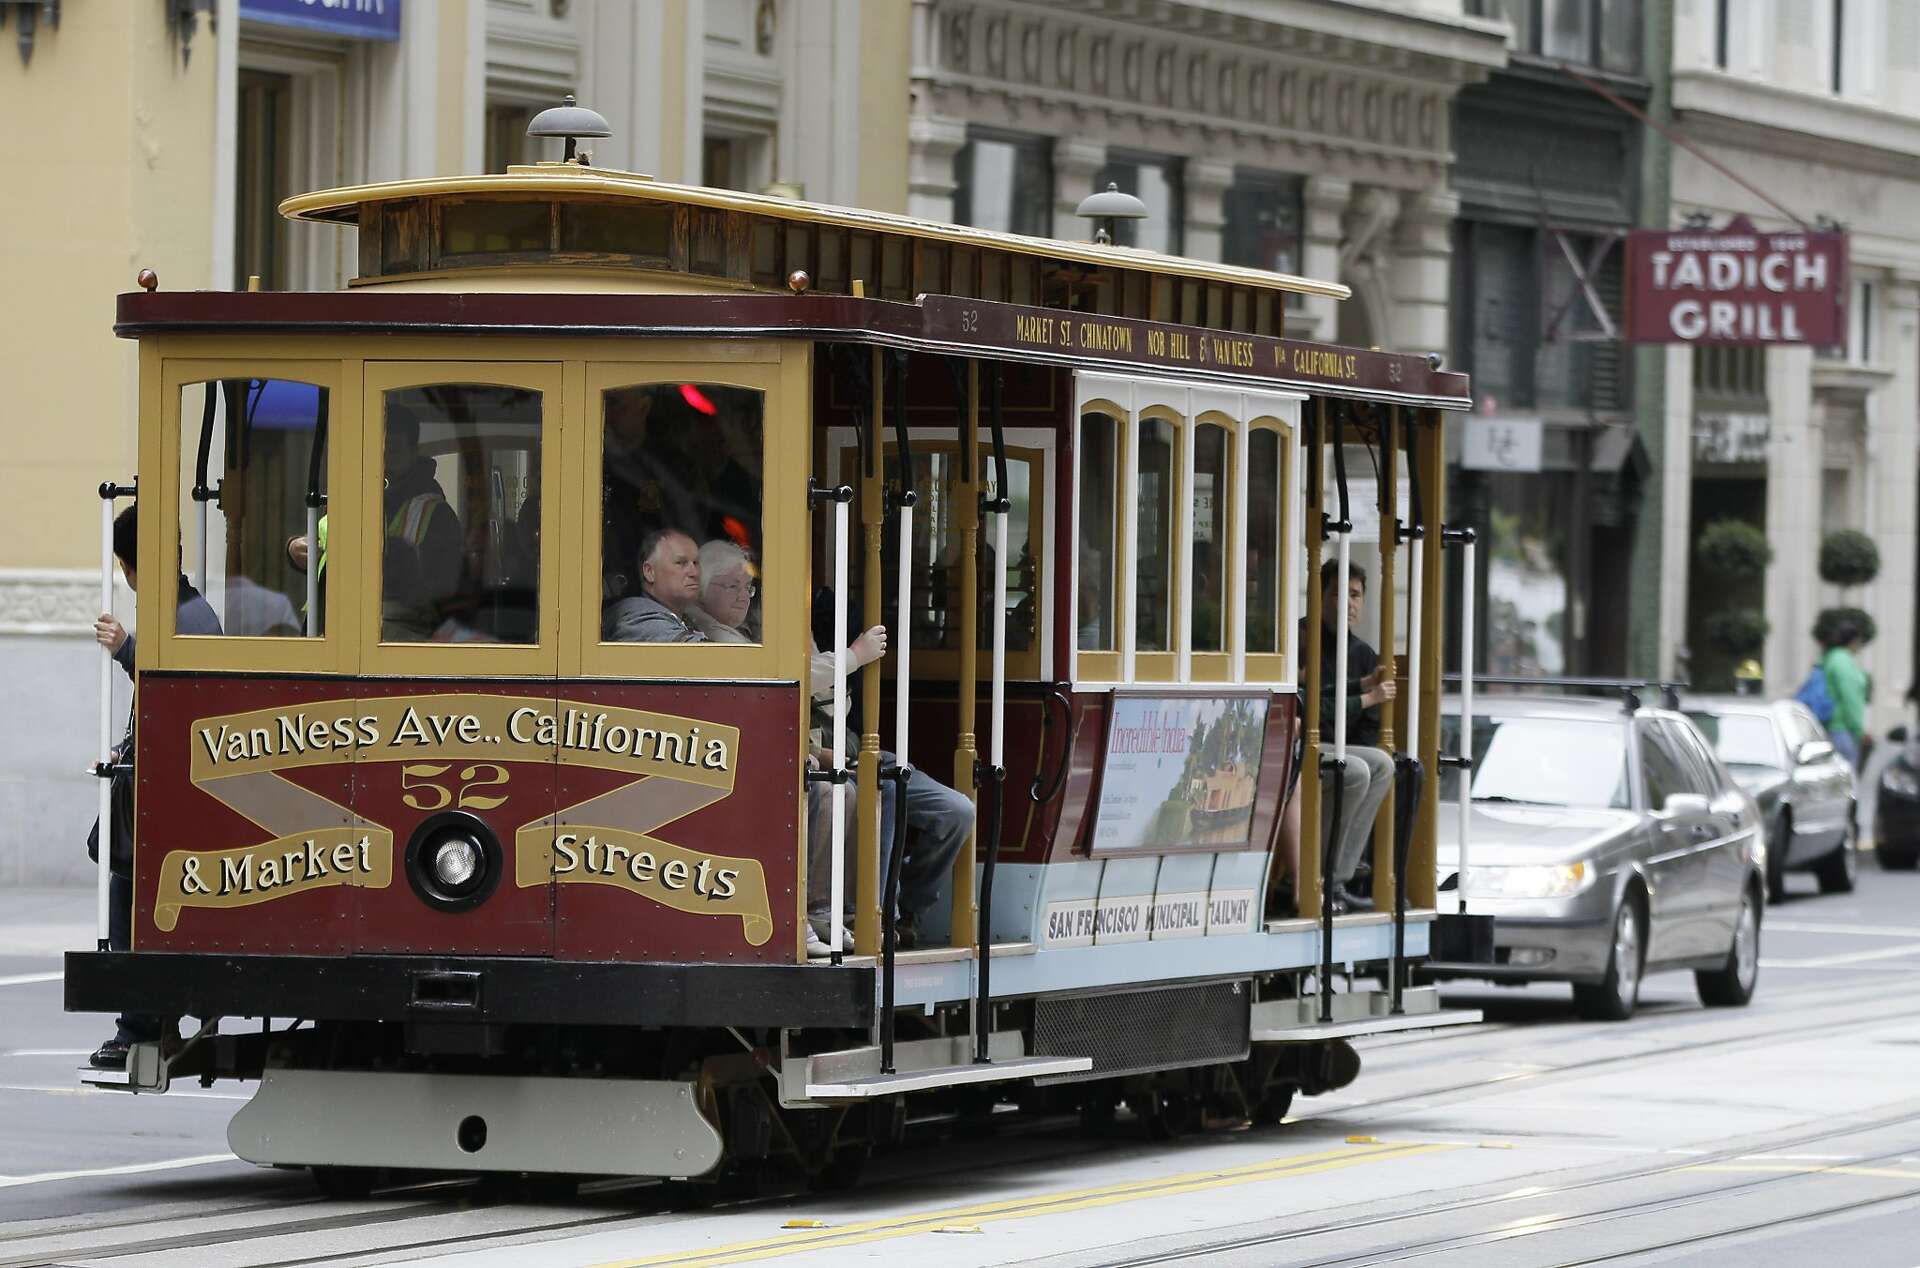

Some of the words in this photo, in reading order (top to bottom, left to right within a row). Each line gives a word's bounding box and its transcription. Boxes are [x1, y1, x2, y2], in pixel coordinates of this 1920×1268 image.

[1650, 252, 1827, 292] TADICH
[961, 310, 978, 333] 52
[1669, 301, 1804, 341] GRILL
[1016, 315, 1054, 344] MARKET
[1080, 323, 1132, 352] CHINATOWN
[1147, 330, 1165, 357] NOB
[1170, 333, 1190, 360] HILL
[1293, 349, 1344, 378] CALIFORNIA
[200, 724, 272, 765] Van
[266, 713, 380, 754] Ness
[507, 707, 728, 771] California
[402, 764, 509, 810] 52
[180, 856, 212, 895] &
[217, 835, 371, 896] Market
[551, 834, 740, 901] Streets
[1049, 911, 1073, 939] SAN
[1076, 905, 1139, 936] FRANCISCO
